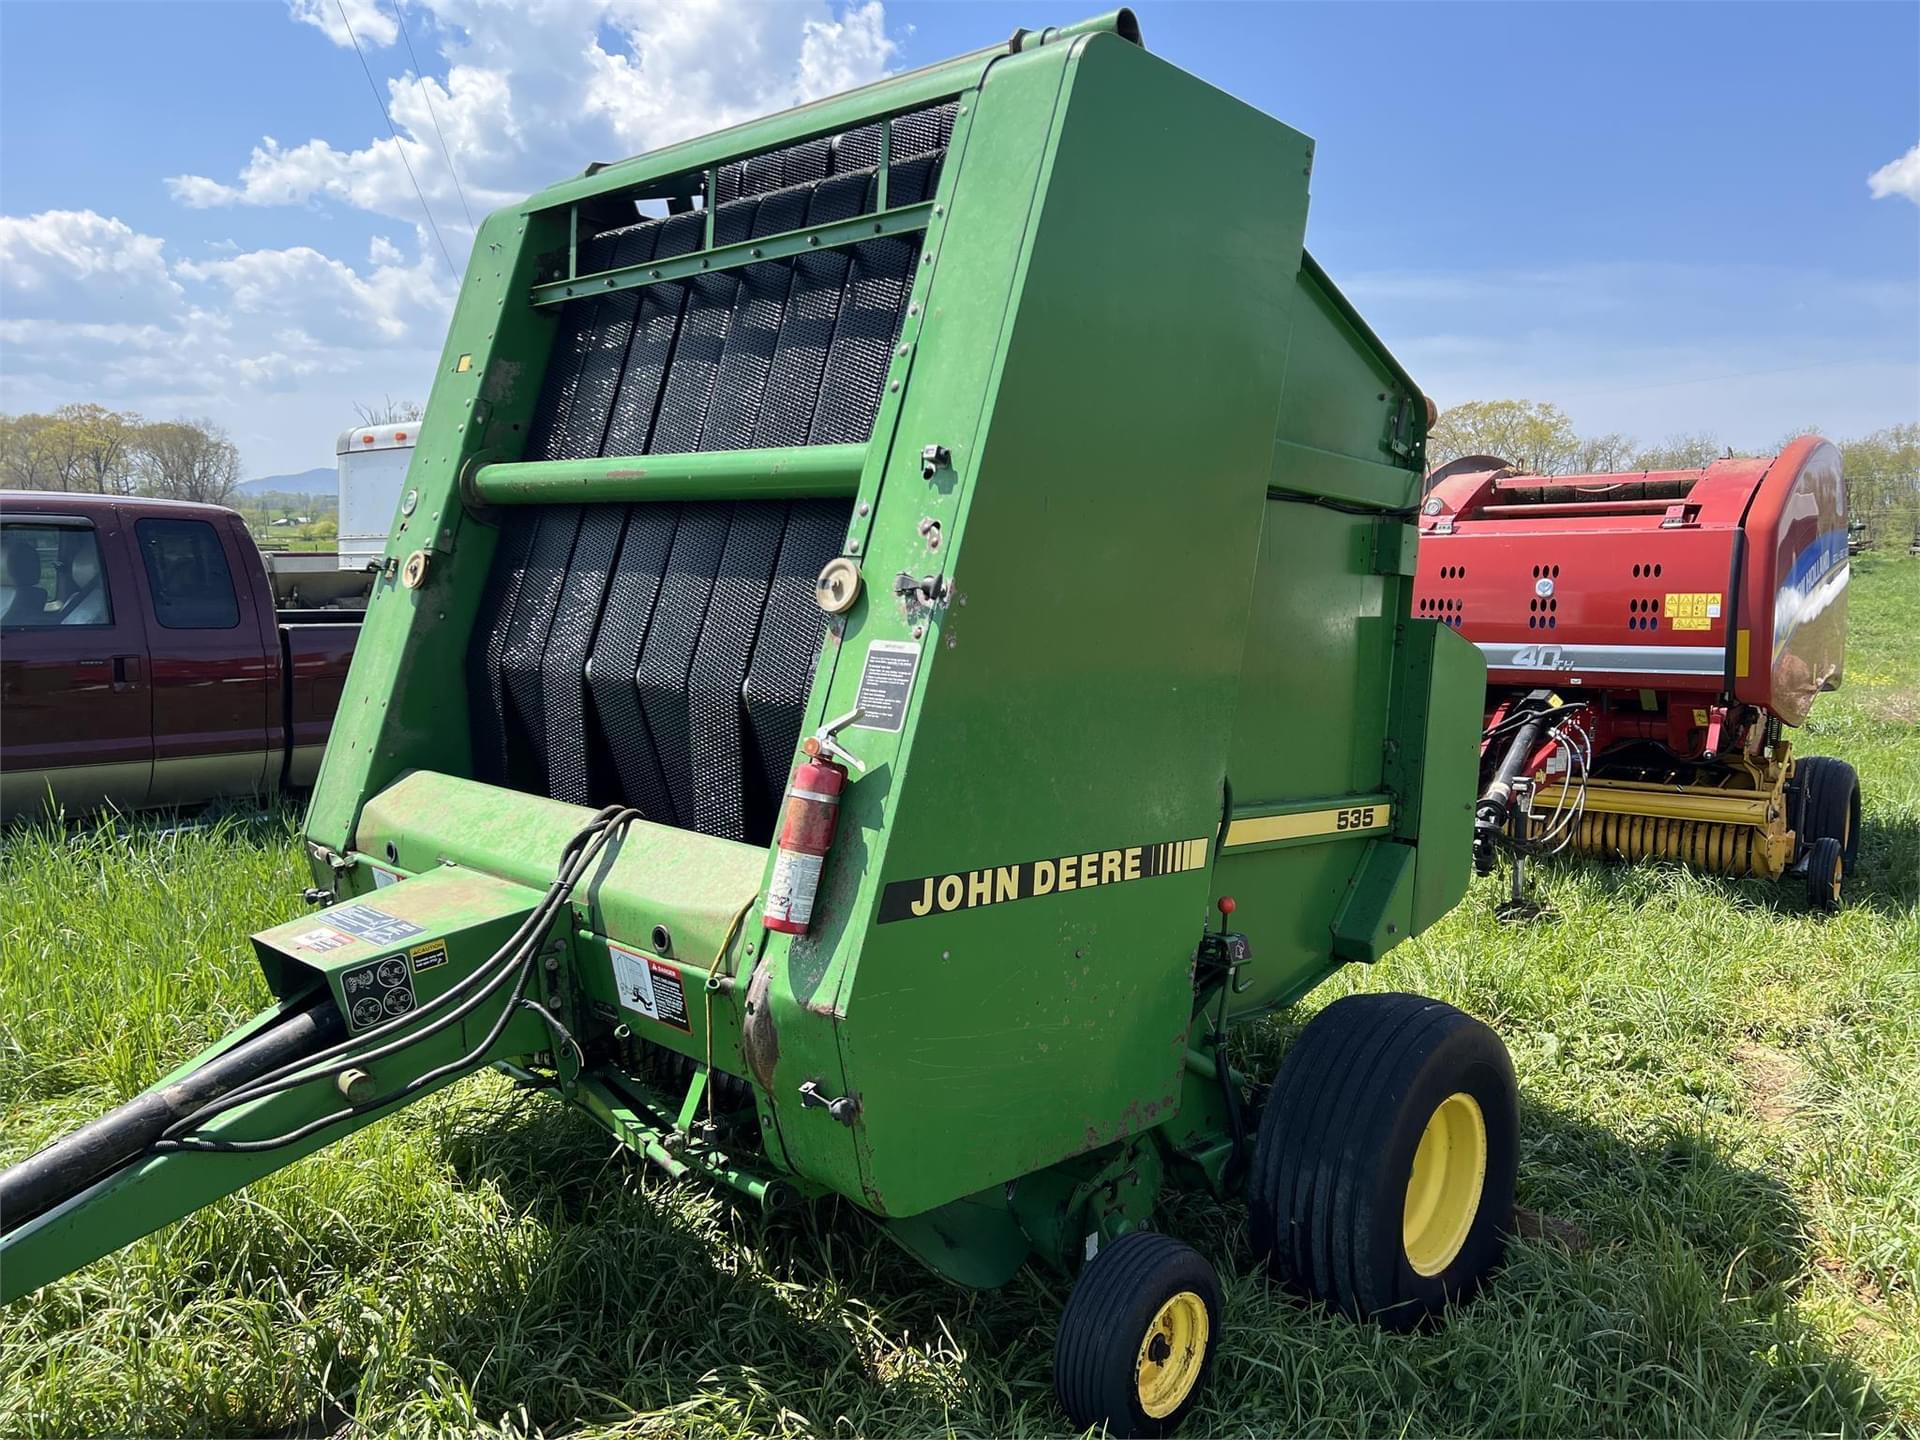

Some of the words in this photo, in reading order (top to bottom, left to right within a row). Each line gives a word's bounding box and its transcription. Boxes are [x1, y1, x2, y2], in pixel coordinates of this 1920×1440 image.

[1337, 808, 1374, 830] 535
[911, 865, 1020, 916] JOHN
[1033, 847, 1142, 896] DEERE
